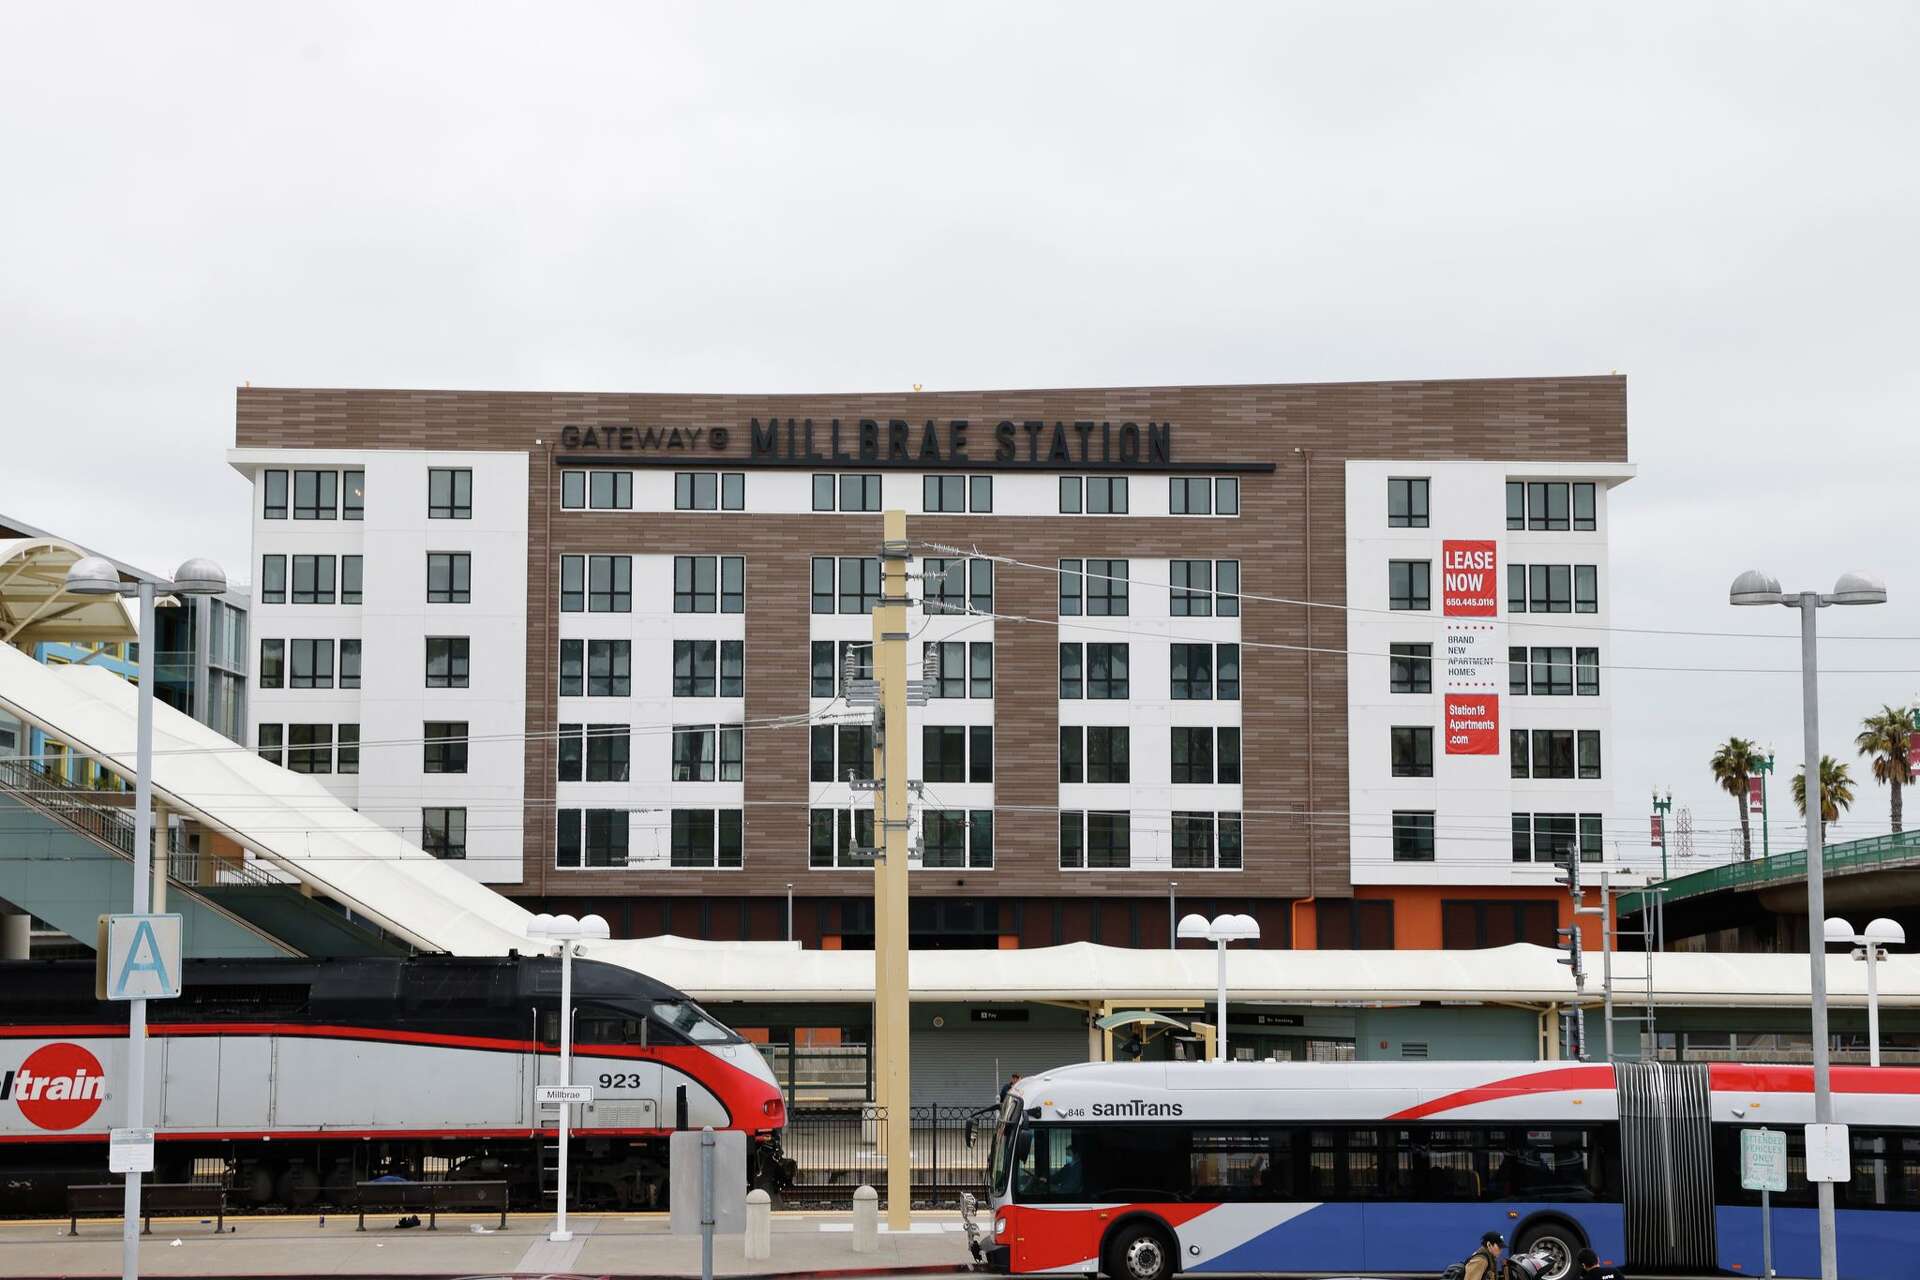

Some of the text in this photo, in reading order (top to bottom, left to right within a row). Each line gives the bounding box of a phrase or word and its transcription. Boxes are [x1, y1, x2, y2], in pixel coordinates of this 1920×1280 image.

[561, 426, 702, 450] GATEWAY
[751, 418, 968, 461] MILLBRAE
[995, 421, 1171, 464] STATION
[1445, 551, 1493, 569] LEASE
[1445, 573, 1483, 592] NOW
[1448, 636, 1475, 644] BRAND
[1448, 646, 1466, 654] NEW
[1448, 657, 1494, 665] APARTMENT
[1448, 668, 1476, 676] HOMES
[1450, 719, 1495, 732] Apartments
[1449, 736, 1468, 744] .com
[115, 920, 170, 993] A
[0, 1069, 105, 1101] ltrain
[599, 1073, 641, 1089] 923
[546, 1088, 580, 1099] Millbrae
[1068, 1099, 1183, 1117] 846 samTrans
[1752, 1153, 1775, 1163] ONLY
